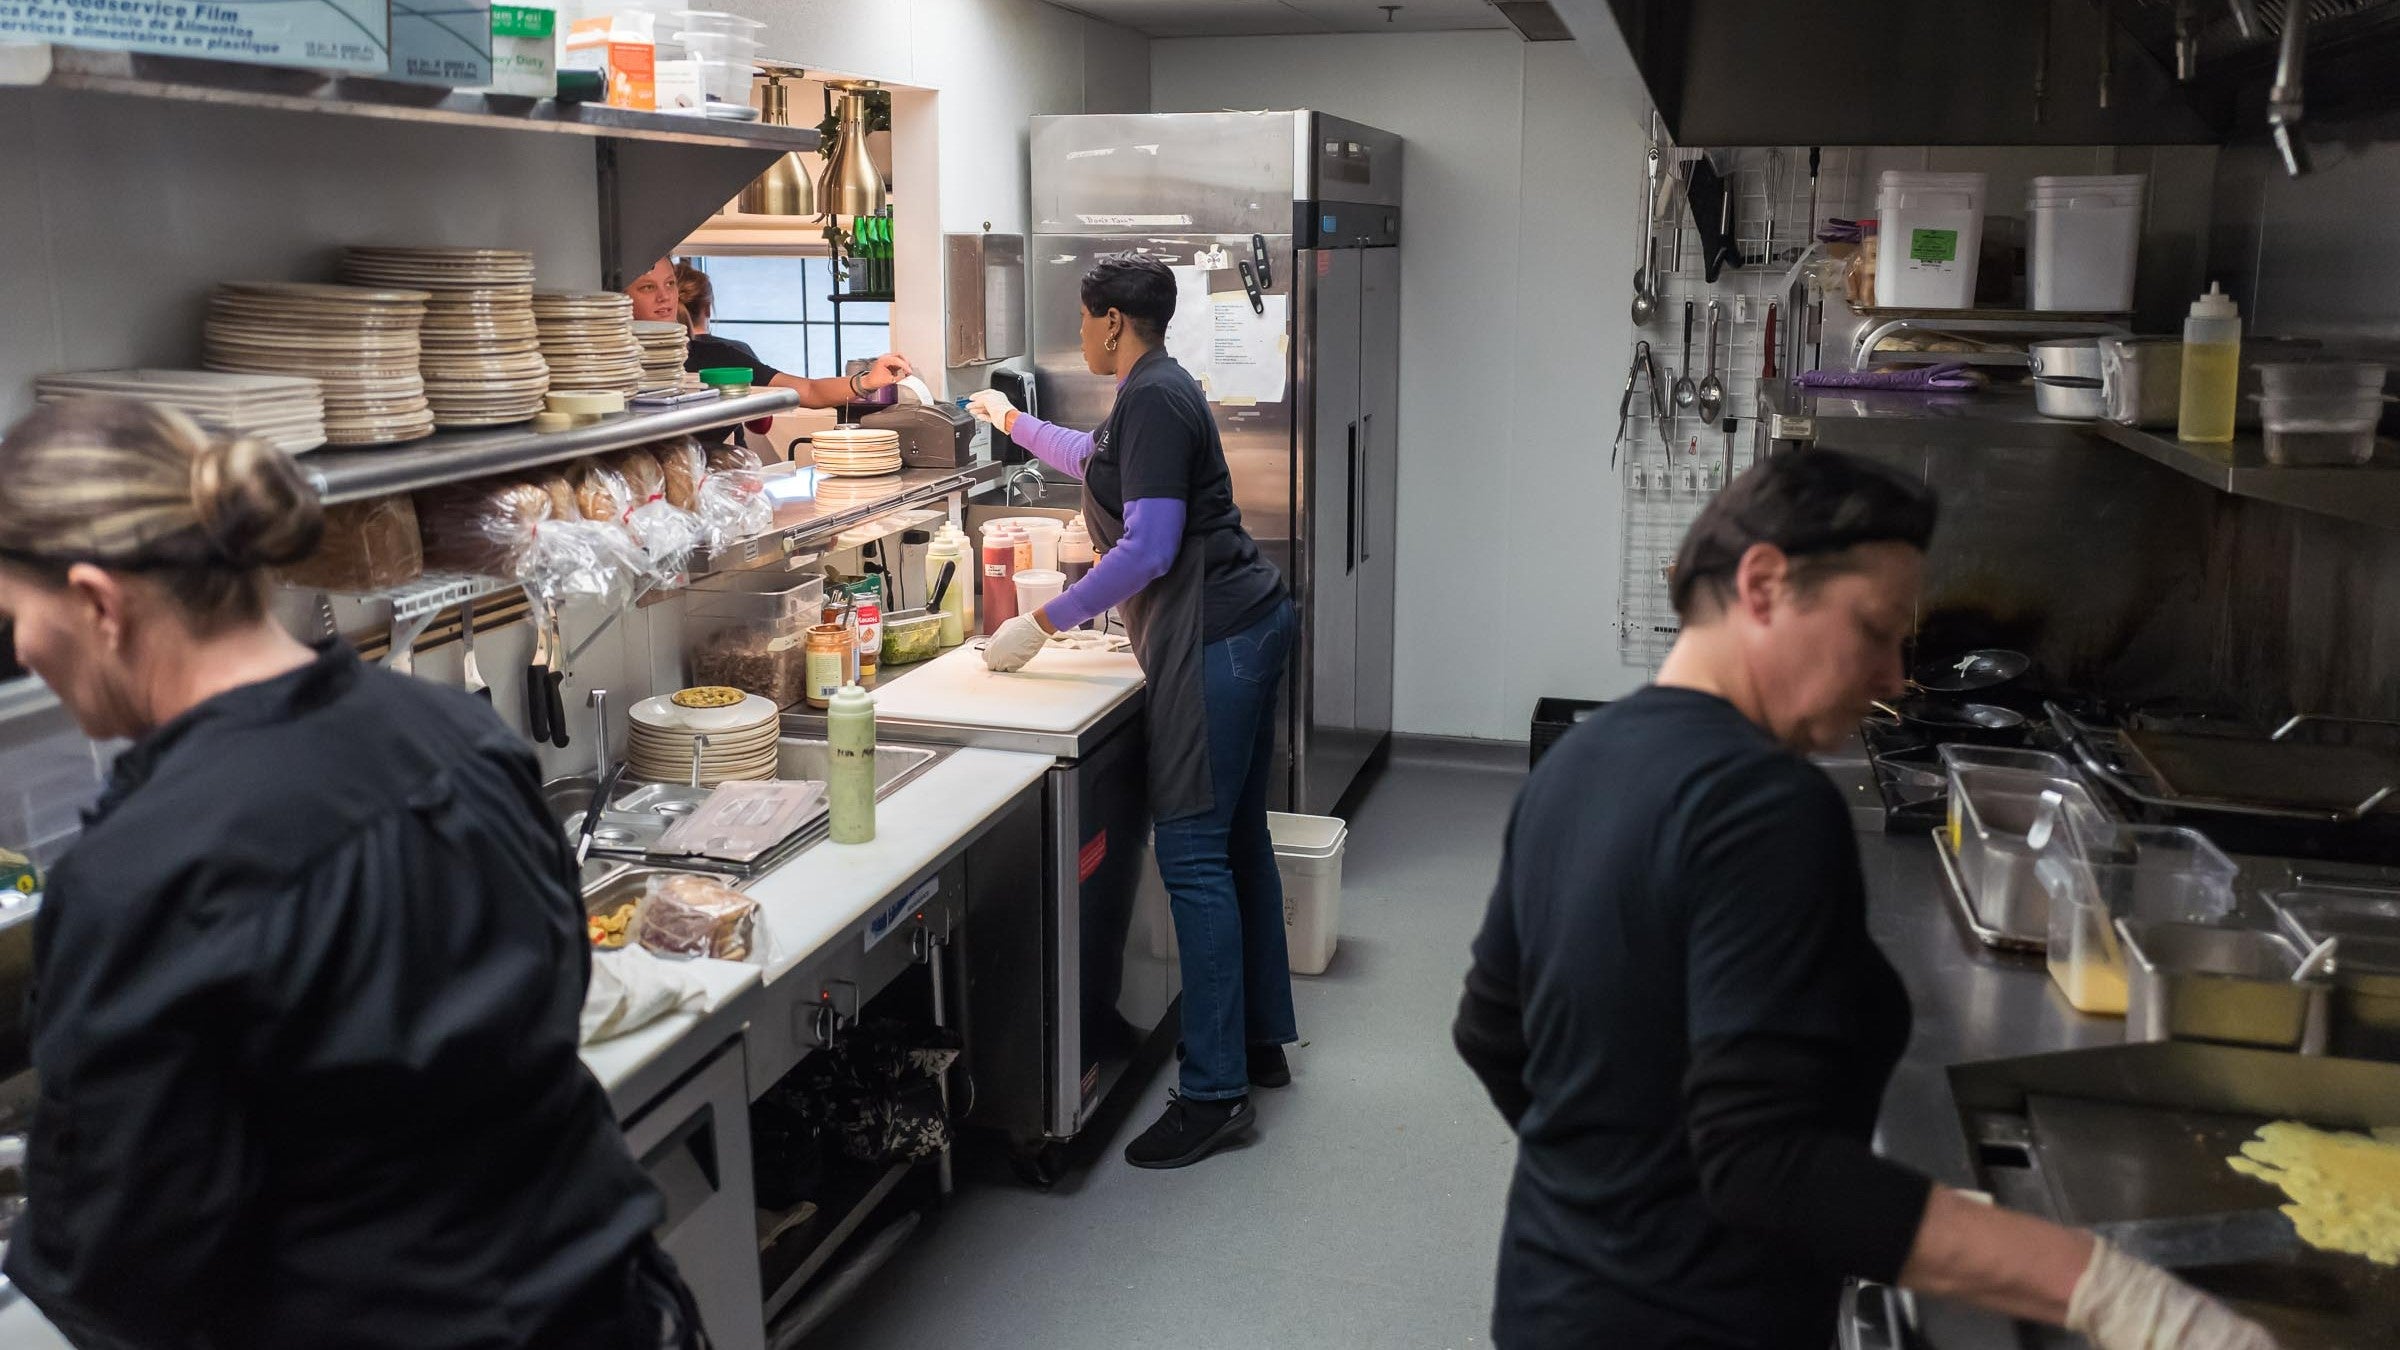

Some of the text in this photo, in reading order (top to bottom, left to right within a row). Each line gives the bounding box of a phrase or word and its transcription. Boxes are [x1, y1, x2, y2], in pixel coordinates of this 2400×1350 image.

[27, 5, 66, 20] Para
[73, 10, 143, 27] Servicio
[149, 19, 167, 29] de
[174, 20, 253, 37] Alimentos
[195, 4, 238, 22] Film
[73, 26, 177, 44] alimentaires
[183, 37, 202, 46] en
[207, 37, 280, 53] plastique
[516, 54, 545, 70] Duty
[858, 616, 878, 624] Honey
